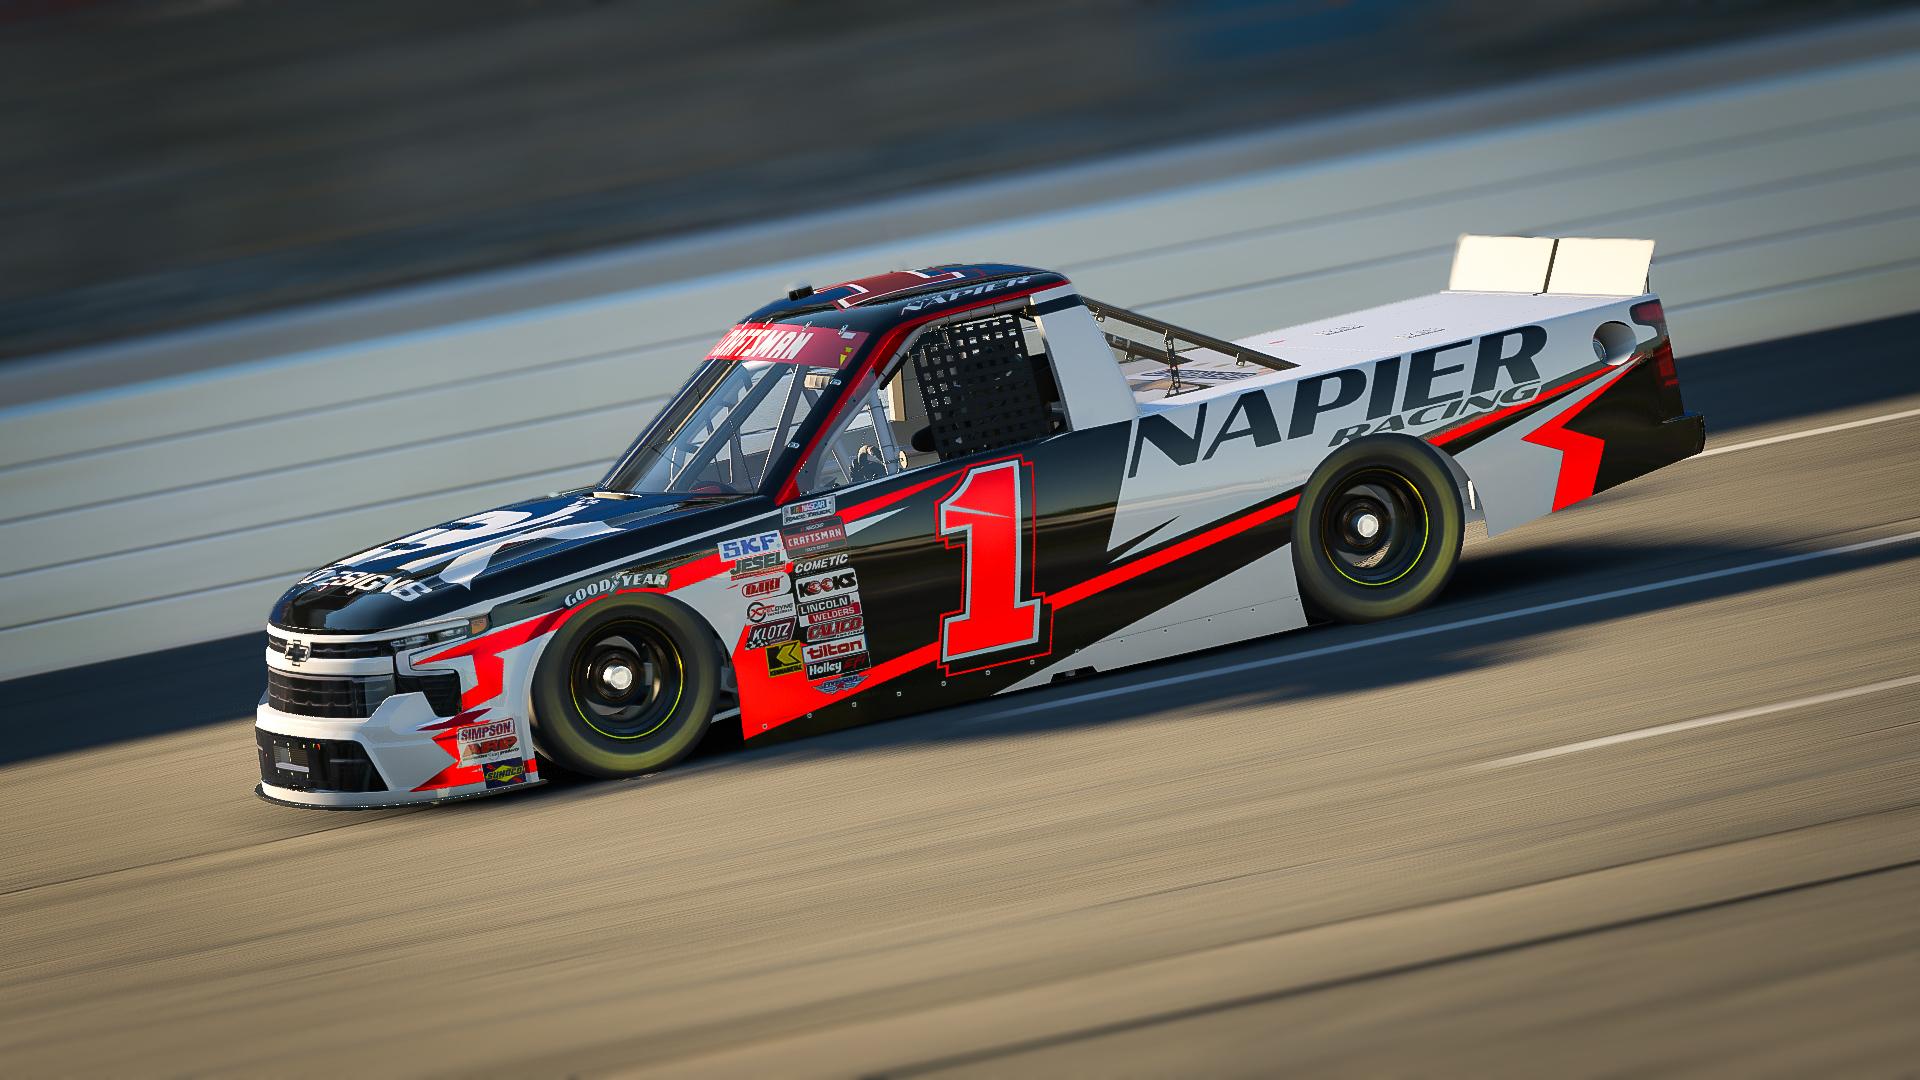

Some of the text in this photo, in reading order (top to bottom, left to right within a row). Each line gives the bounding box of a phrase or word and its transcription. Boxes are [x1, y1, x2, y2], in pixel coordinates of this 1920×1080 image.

[901, 275, 1031, 317] NAPIER
[1128, 324, 1547, 479] NAPIER
[1328, 379, 1542, 448] RACING
[722, 532, 778, 559] SKF
[788, 528, 842, 547] CRAFTSMAN
[729, 551, 786, 576] JESEL
[794, 553, 849, 574] COMETIC
[937, 457, 1047, 670] 1
[800, 597, 848, 615] LINCOLN
[812, 607, 855, 622] WELDERS
[752, 622, 791, 641] KLOTZ
[807, 616, 864, 640] CALICO
[806, 640, 863, 660] tilton
[809, 661, 842, 676] Holley
[460, 720, 511, 741] SIMPSON
[485, 765, 524, 780] SUNOCO
